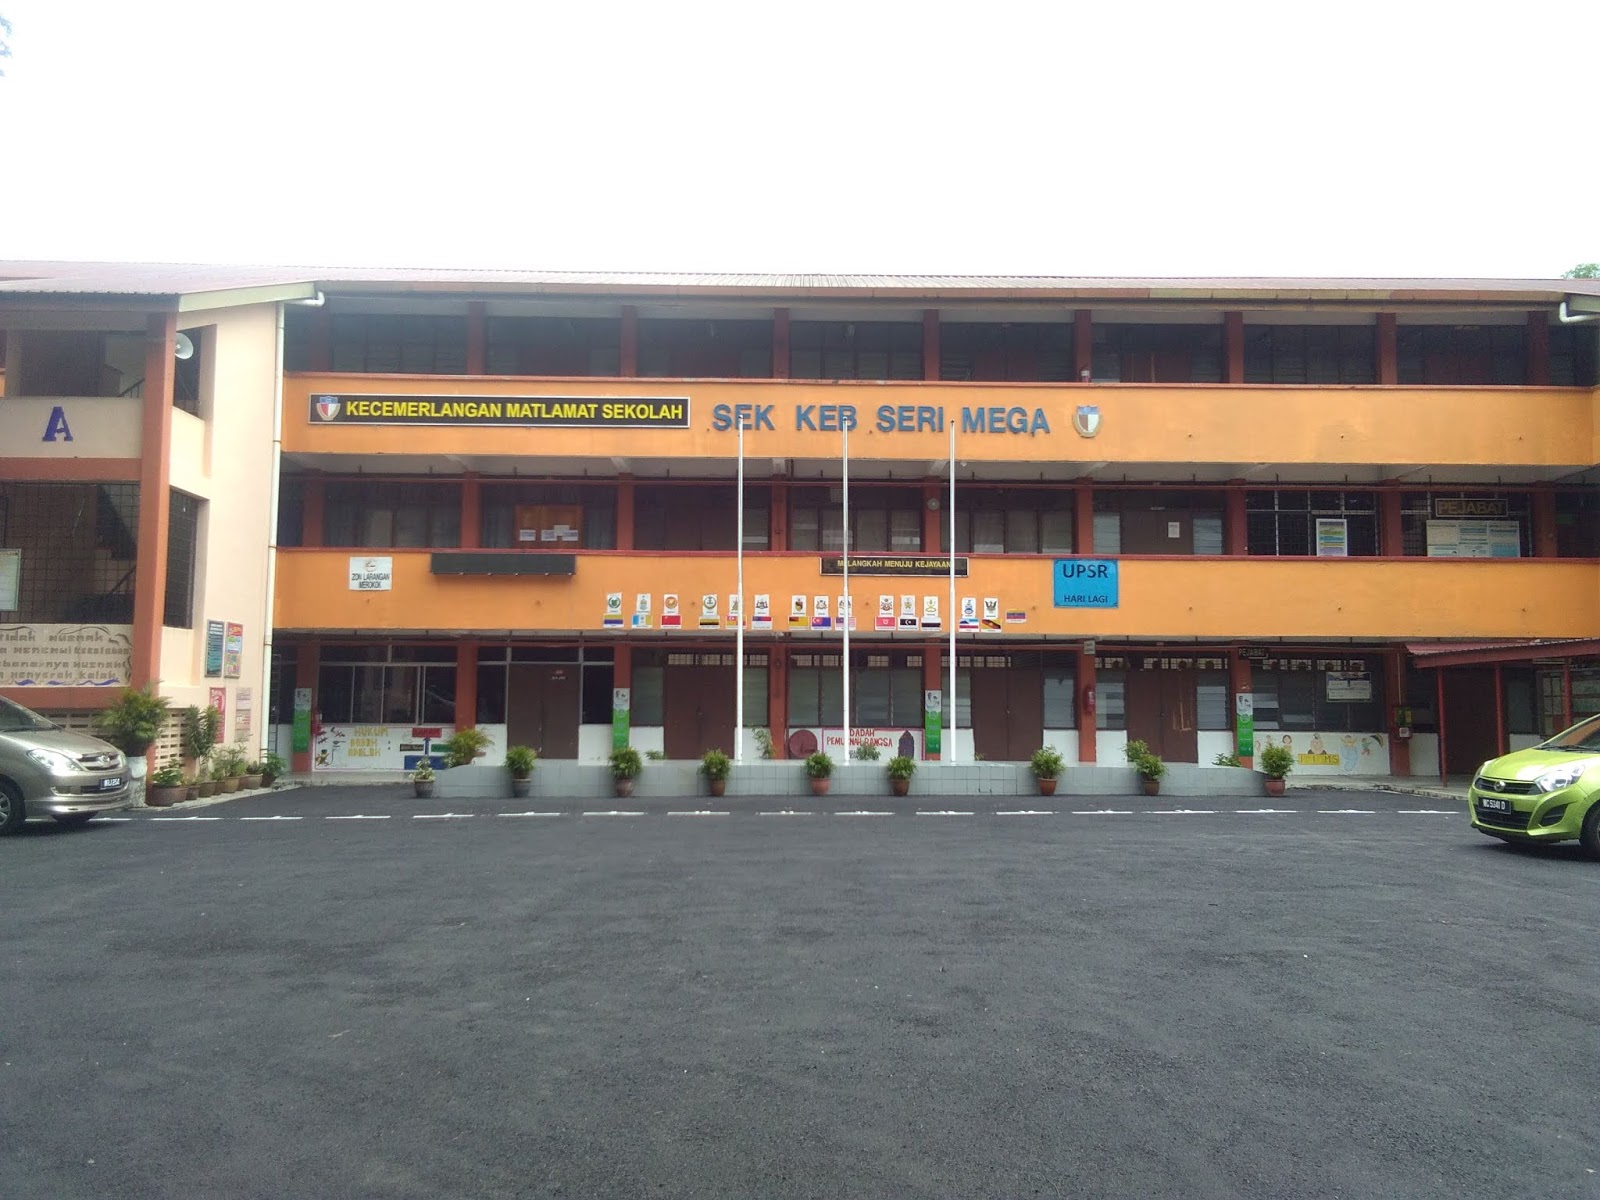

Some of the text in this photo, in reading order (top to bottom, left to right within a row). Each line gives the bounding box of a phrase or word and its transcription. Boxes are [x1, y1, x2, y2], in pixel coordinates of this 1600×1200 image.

[346, 401, 683, 420] KECEMERLANGAN MATLAMAT SEKOLAH
[42, 406, 73, 441] A
[712, 404, 1051, 434] SEK KEB SERI MEGA
[1438, 500, 1504, 515] PEJABAT
[837, 559, 882, 568] MLANGKAH
[885, 560, 913, 568] MENUJU
[1063, 563, 1109, 578] UPSR
[351, 573, 390, 581] ZON LARANGAN
[359, 581, 382, 589] MEROKOK
[1064, 595, 1108, 603] HARI LAGI
[849, 728, 875, 737] DADAH
[826, 736, 861, 746] PEMUNAH
